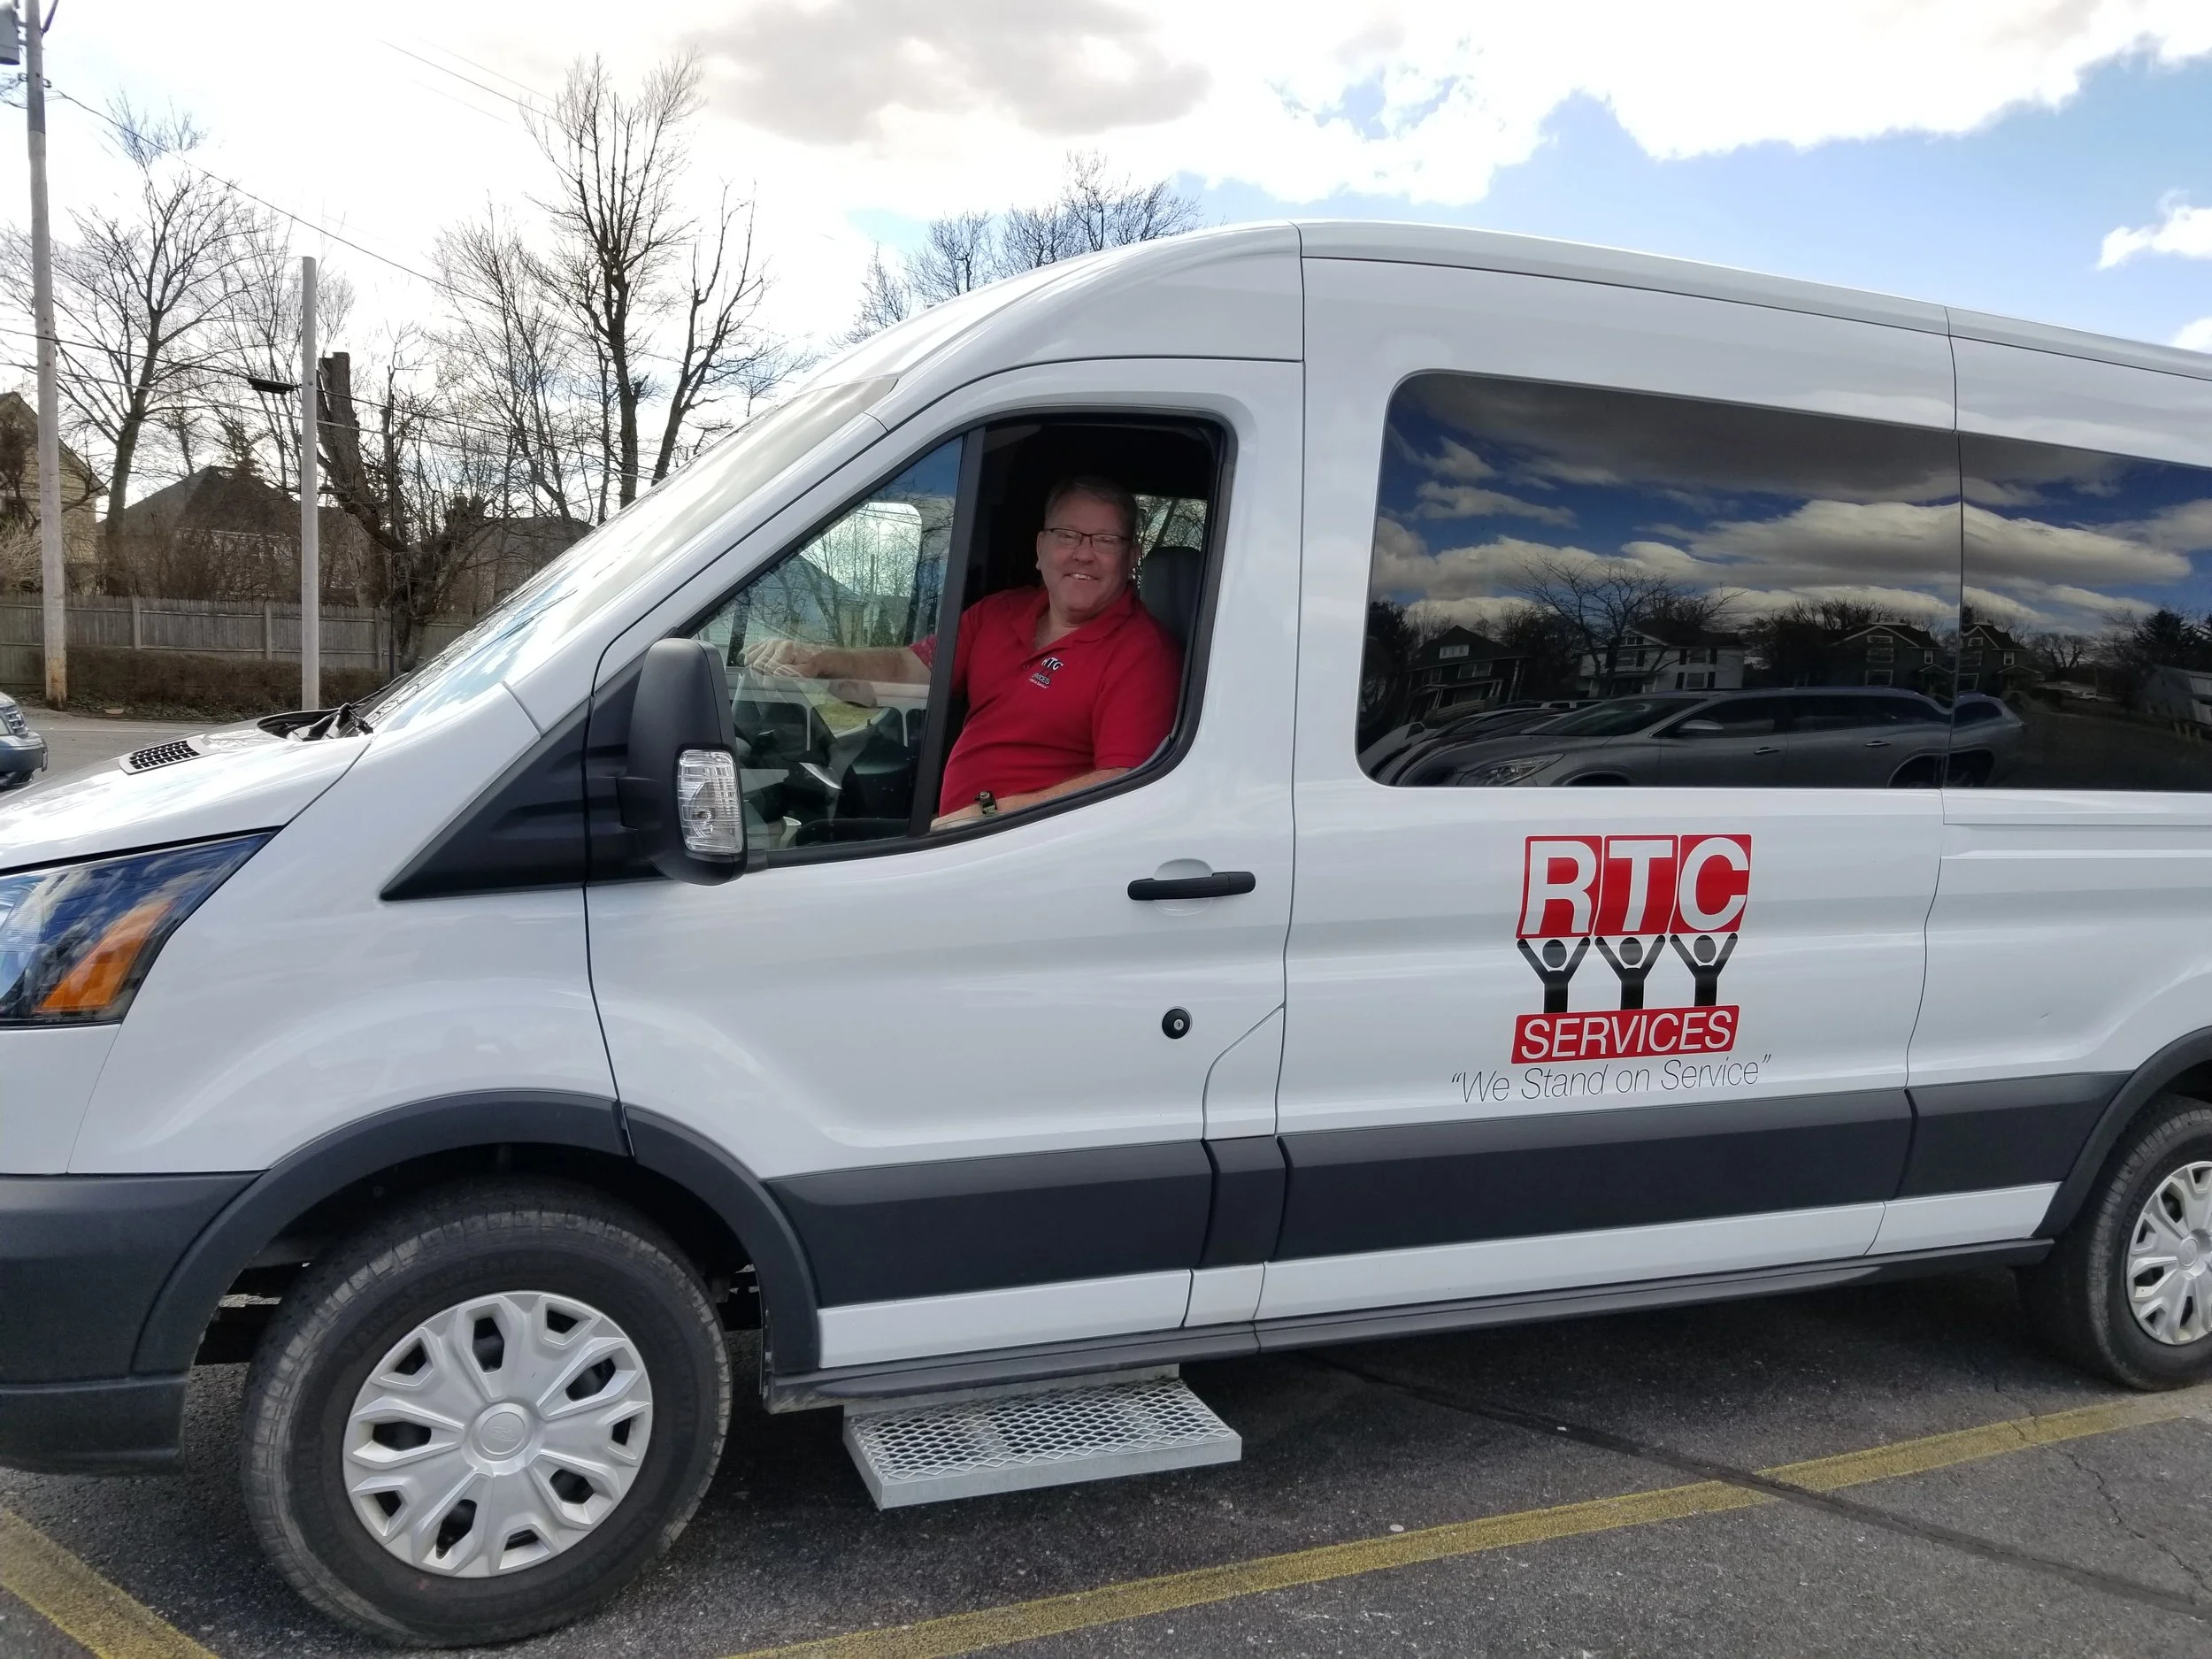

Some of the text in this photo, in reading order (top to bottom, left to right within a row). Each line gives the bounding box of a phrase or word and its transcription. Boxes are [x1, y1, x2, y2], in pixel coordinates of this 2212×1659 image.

[1520, 836, 1749, 935] RTC
[1520, 1010, 1732, 1059] SERVICES
[1451, 1054, 1772, 1103] “We Stand on Service”
